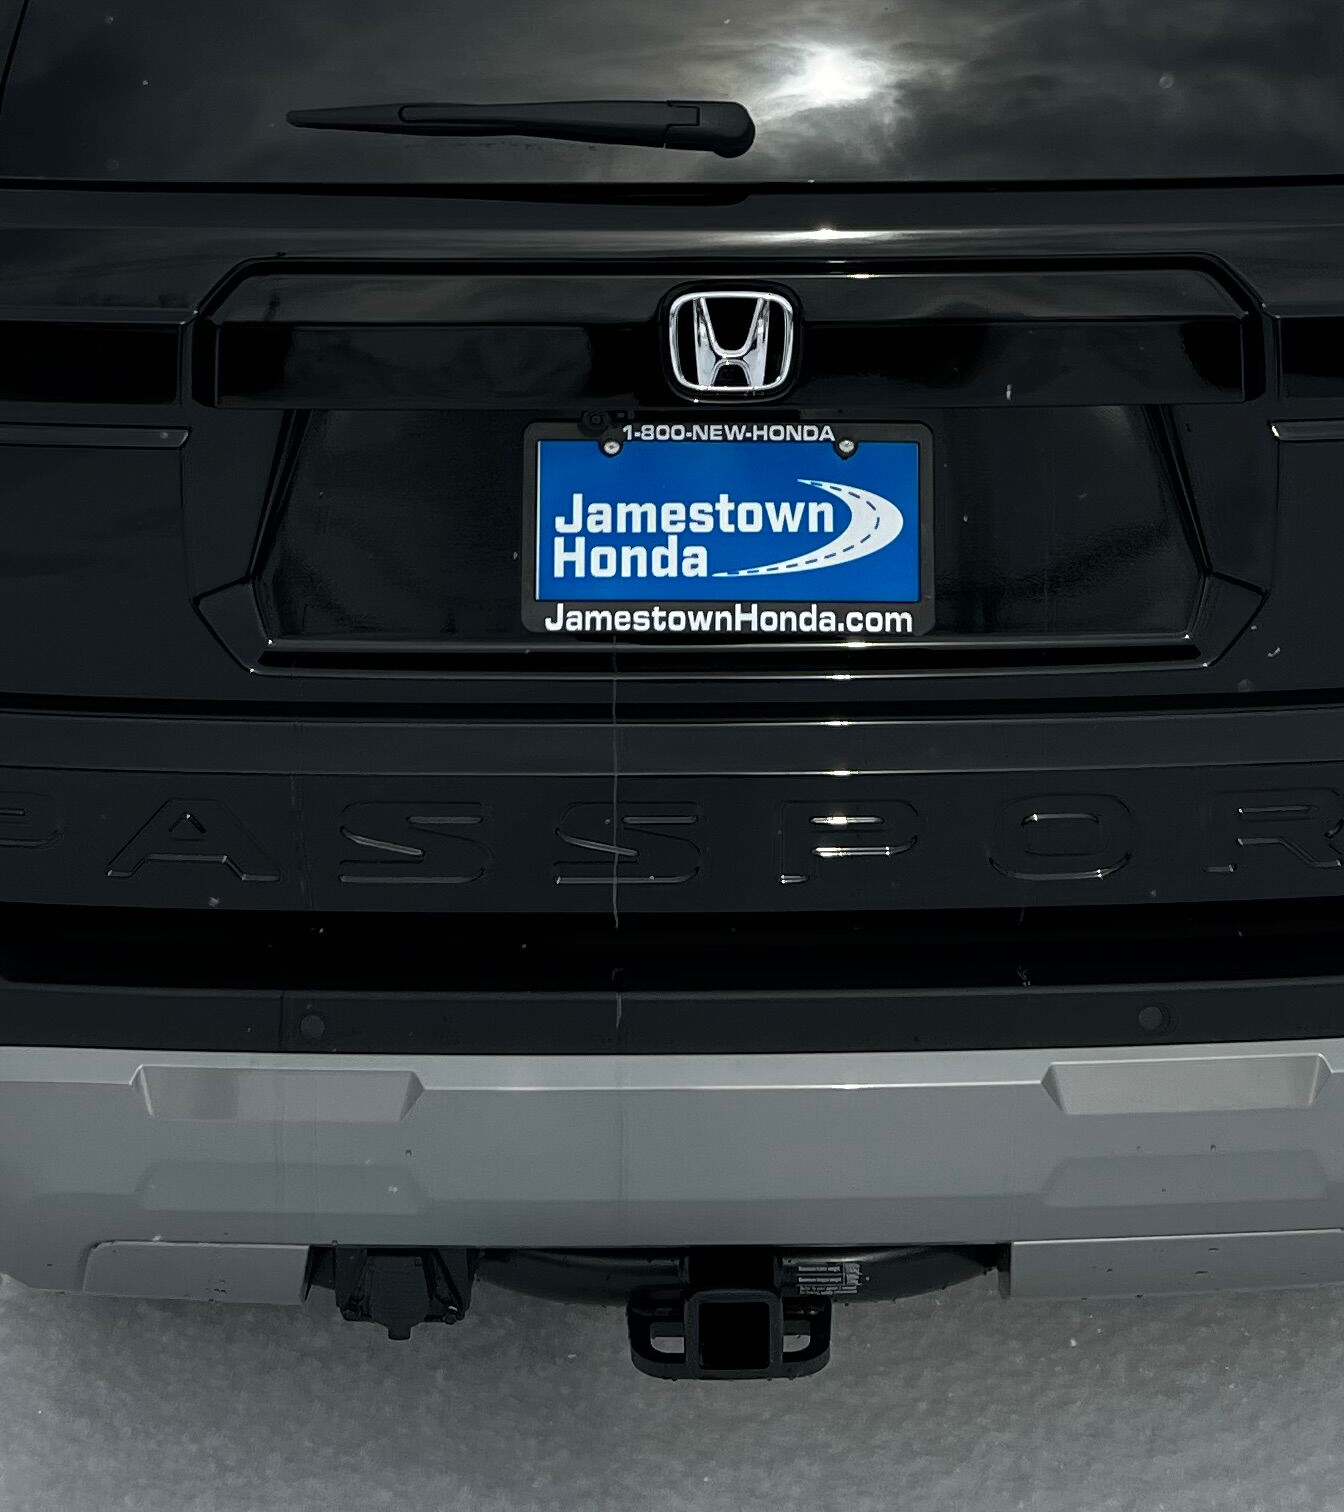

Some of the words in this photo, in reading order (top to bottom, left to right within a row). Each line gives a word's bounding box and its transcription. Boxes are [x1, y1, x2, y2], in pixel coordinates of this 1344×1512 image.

[622, 424, 836, 442] 1-800-NEW-HONDA
[554, 493, 835, 534] Jamestown
[553, 534, 709, 578] Honda
[544, 603, 914, 633] JamestownHonda.com
